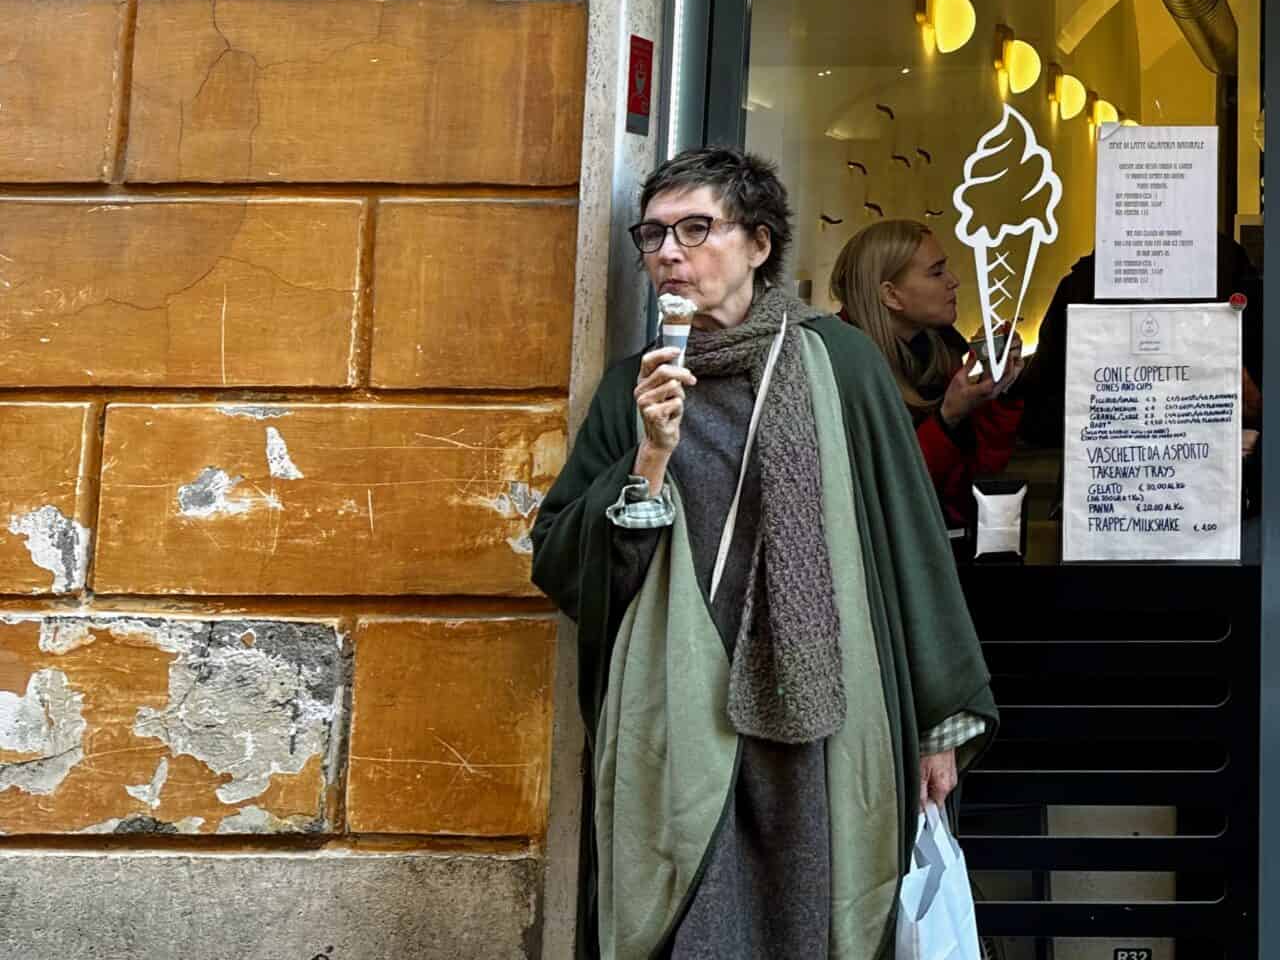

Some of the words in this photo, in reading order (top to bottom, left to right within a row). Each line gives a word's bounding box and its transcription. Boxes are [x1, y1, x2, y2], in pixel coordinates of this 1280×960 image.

[1094, 366, 1122, 383] CONI
[1134, 366, 1190, 382] COPPETTE
[1096, 383, 1119, 392] CONES
[1162, 444, 1208, 459] ASPORTO
[1088, 466, 1141, 479] TAKEAWAY
[1143, 466, 1176, 478] TRAYS
[1088, 483, 1122, 494] GELATO
[1089, 503, 1114, 513] PANNA
